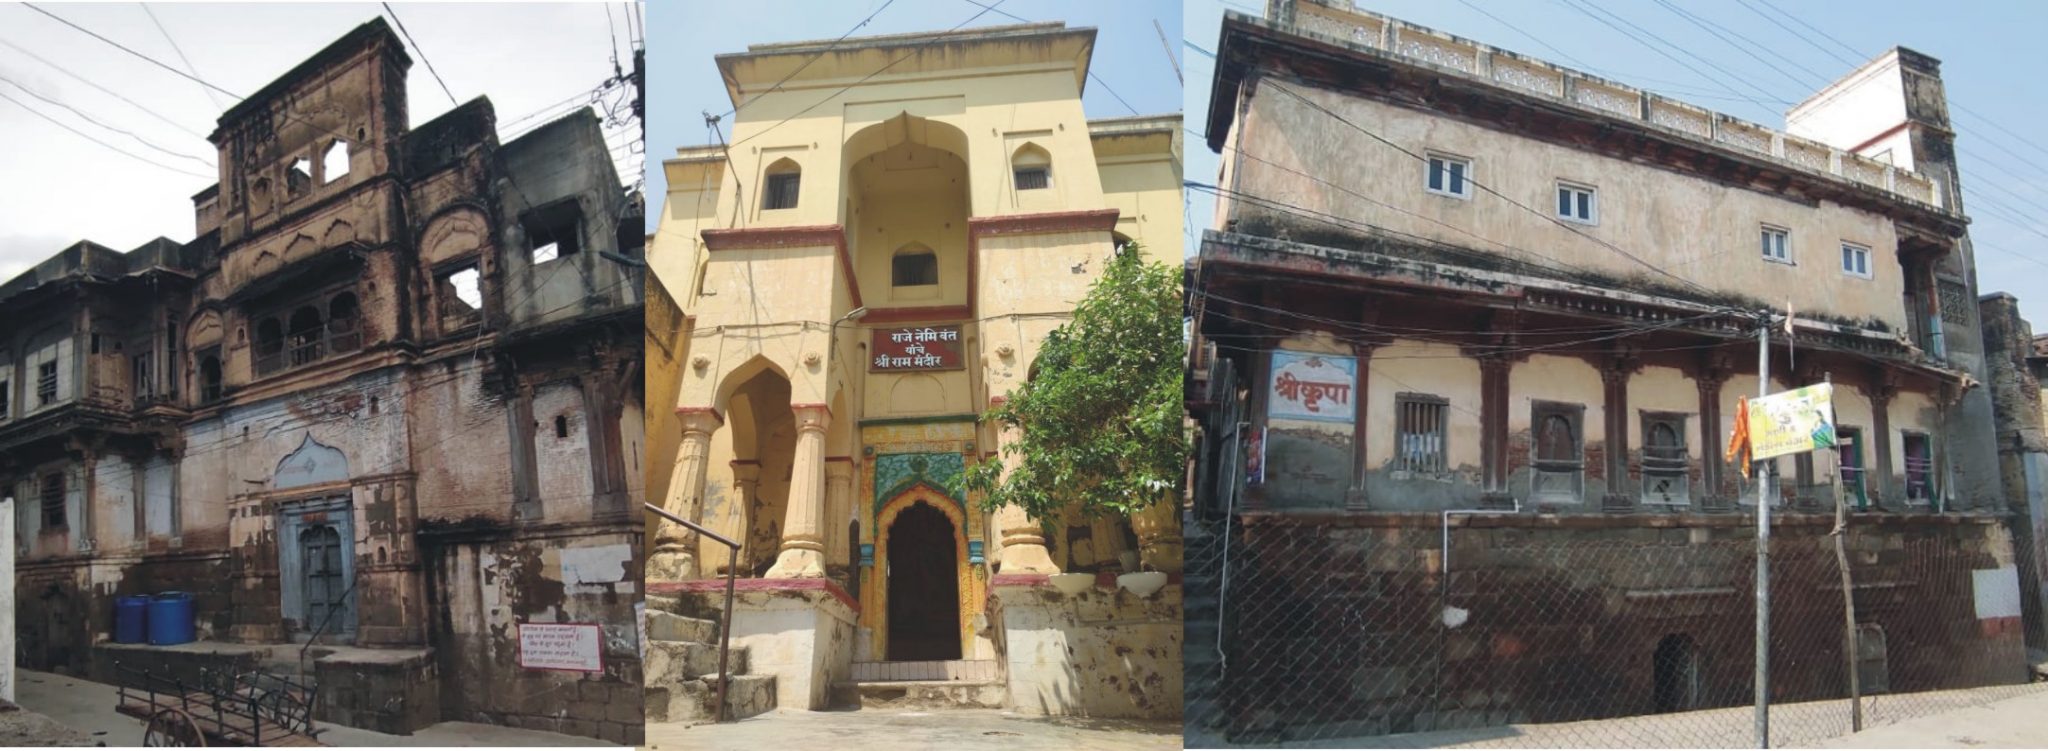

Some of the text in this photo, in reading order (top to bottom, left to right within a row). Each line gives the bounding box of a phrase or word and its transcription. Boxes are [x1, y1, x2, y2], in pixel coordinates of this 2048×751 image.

[892, 328, 913, 343] राजे
[905, 342, 925, 355] यांचे
[874, 352, 942, 368] श्री राम मंदीर
[1274, 371, 1351, 413] श्रीकृपा
